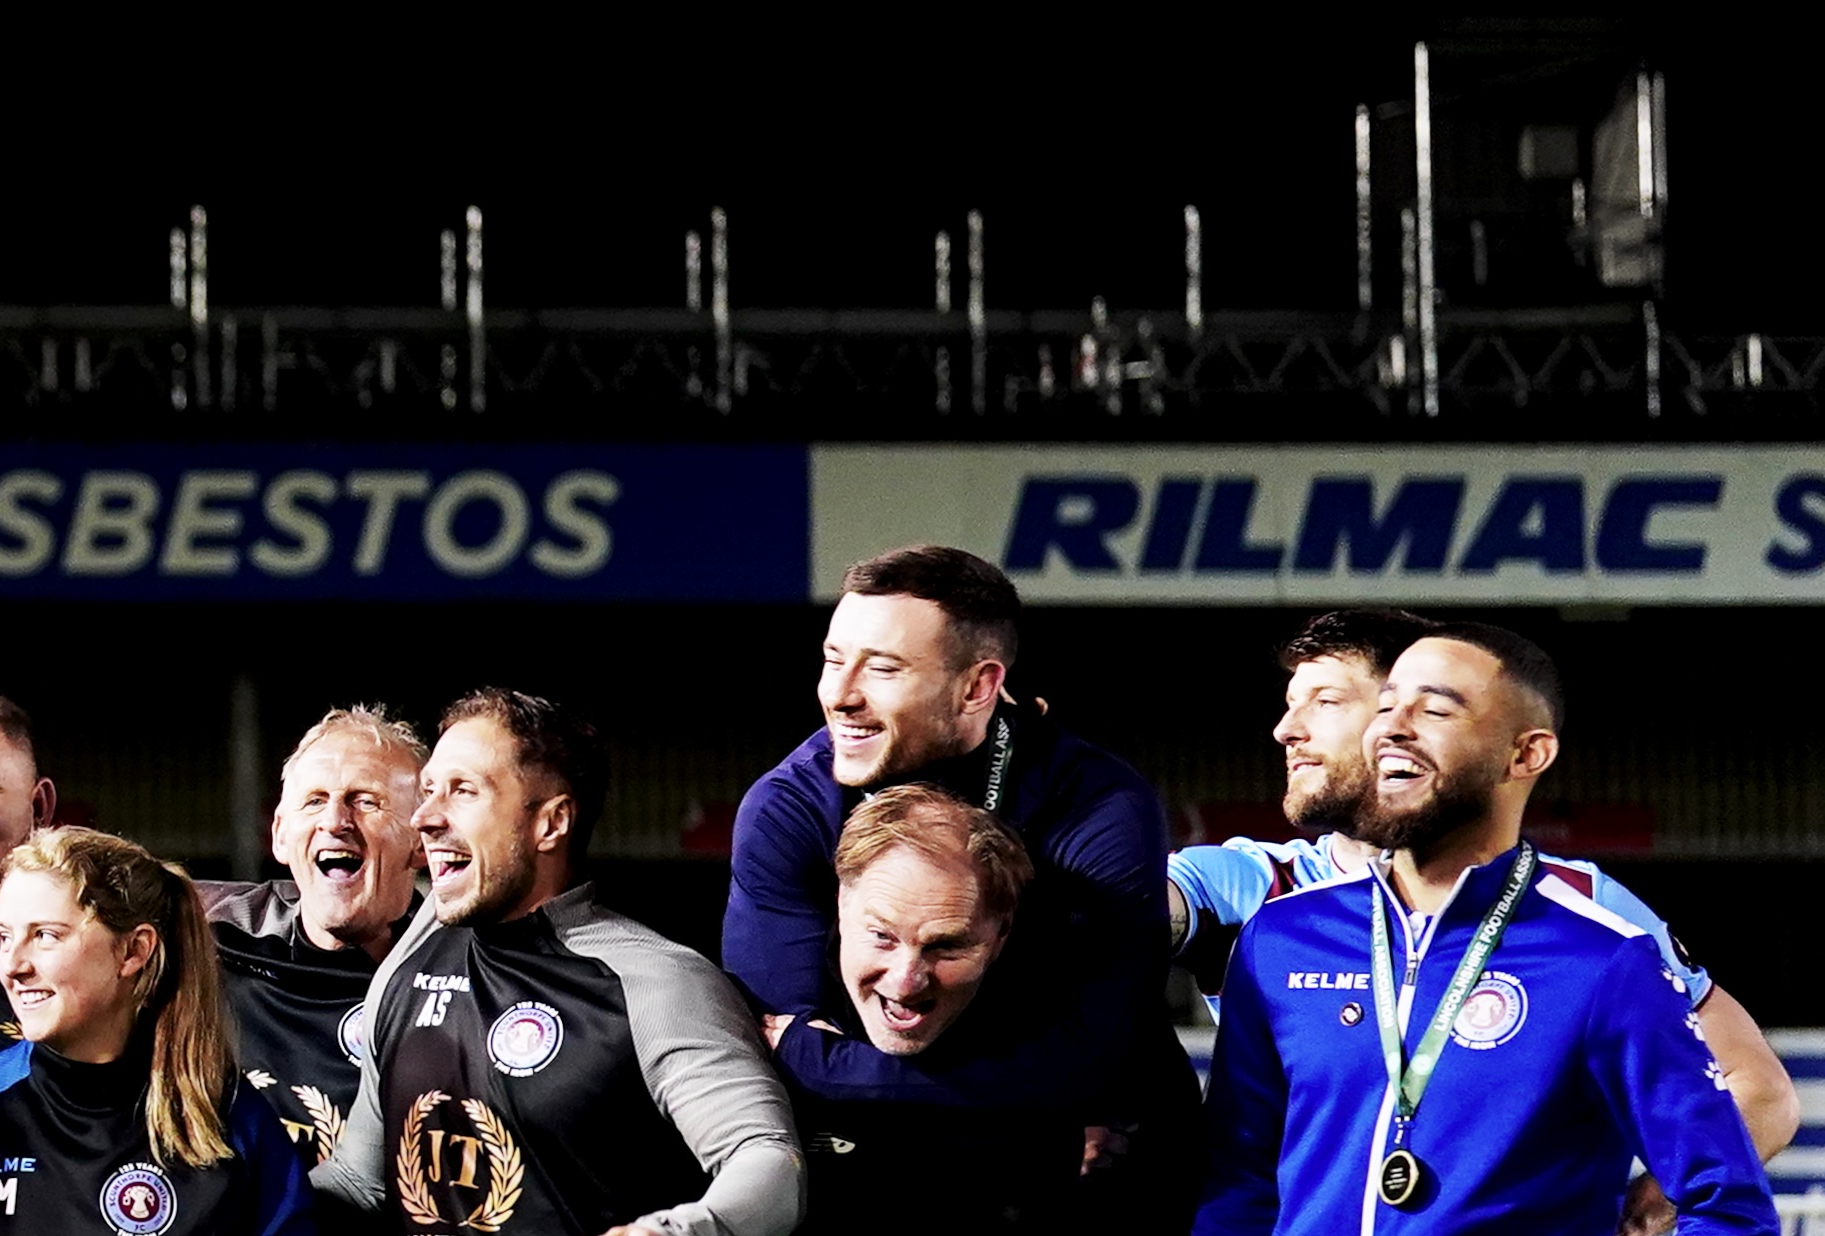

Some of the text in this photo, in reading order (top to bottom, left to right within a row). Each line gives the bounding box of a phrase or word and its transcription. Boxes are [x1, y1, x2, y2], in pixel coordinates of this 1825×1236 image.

[1002, 474, 1724, 574] RILMAC
[983, 750, 1006, 811] OOTBALL
[413, 972, 470, 992] KELME
[1288, 972, 1370, 990] KELME
[1434, 883, 1516, 1031] LINCOLNSHIRE FOOTBALL
[415, 990, 452, 1027] AS
[426, 1128, 486, 1189] JT
